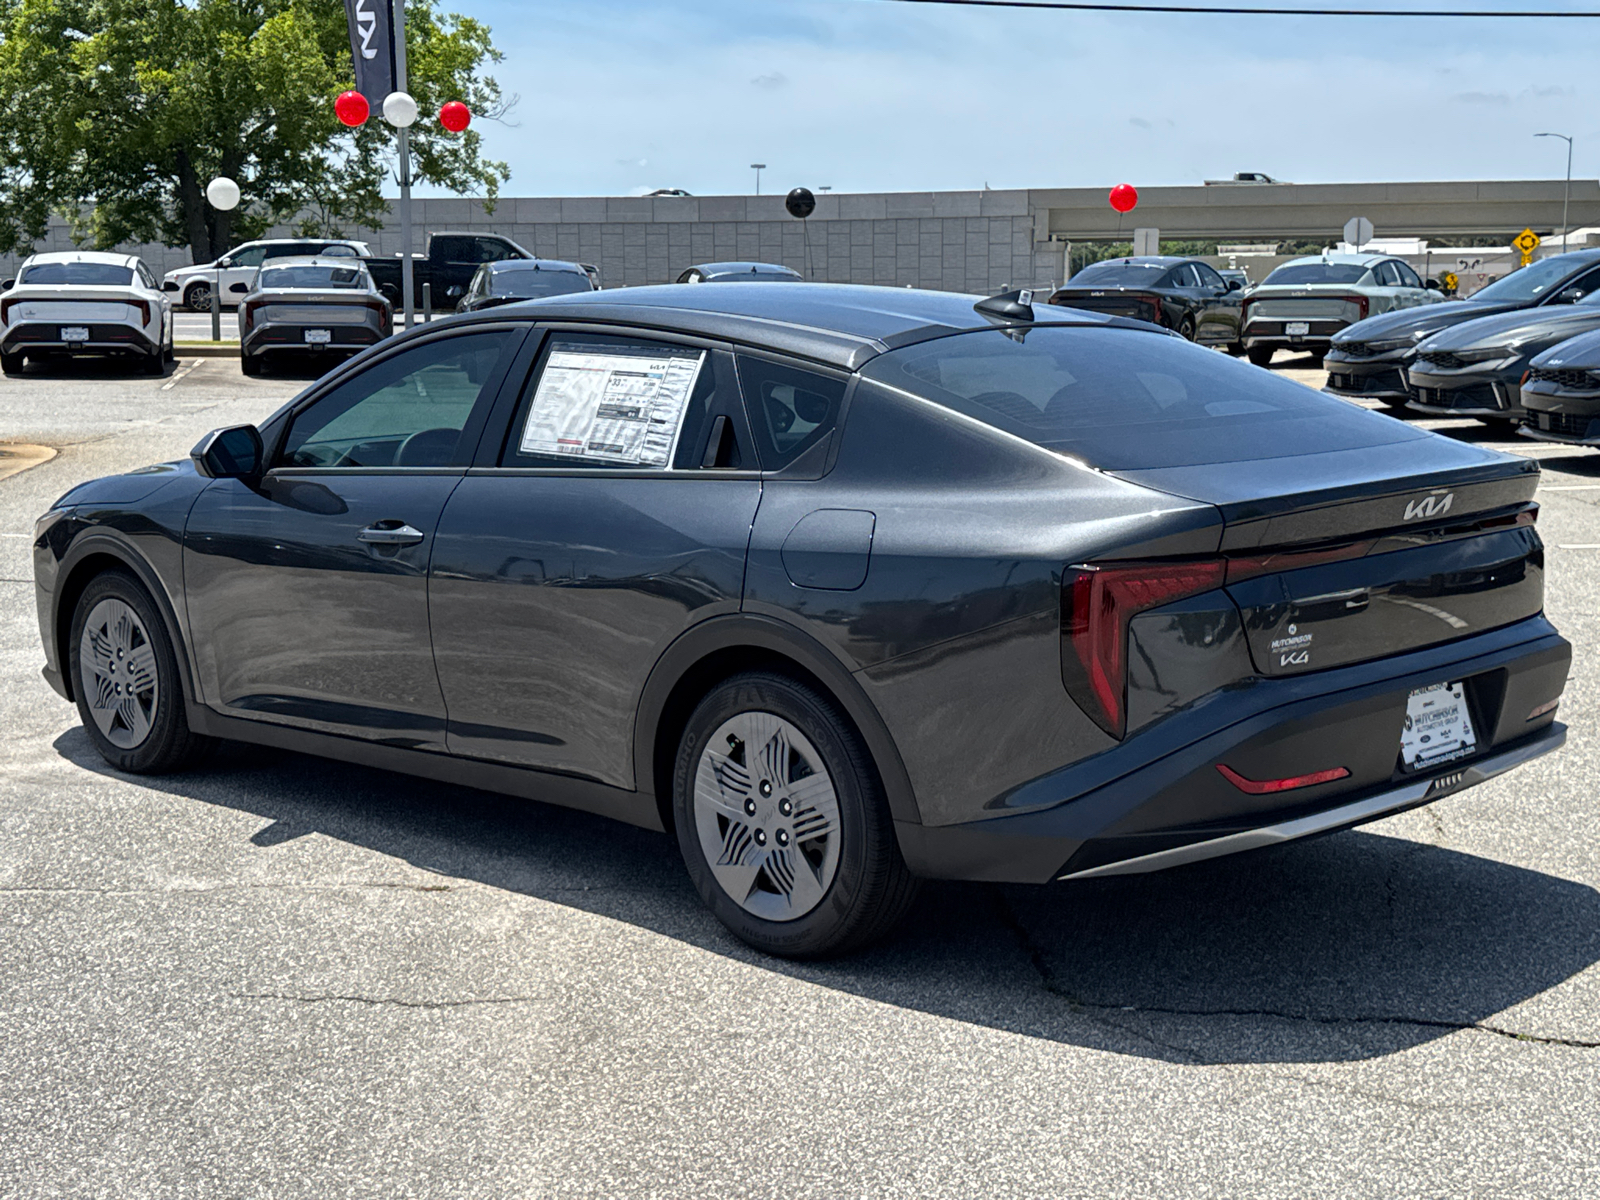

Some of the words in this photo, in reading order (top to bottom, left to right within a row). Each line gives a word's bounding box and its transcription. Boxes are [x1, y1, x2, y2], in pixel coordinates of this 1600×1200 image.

[611, 378, 621, 387] 33
[1403, 493, 1454, 520] KIA
[1271, 633, 1313, 648] HUTCHINSON
[1280, 650, 1309, 667] K4
[1413, 704, 1459, 726] HUTCHINSON
[1416, 720, 1444, 733] AUTOMOTIVE
[1444, 716, 1459, 726] GROUP
[676, 732, 696, 808] KUMHO
